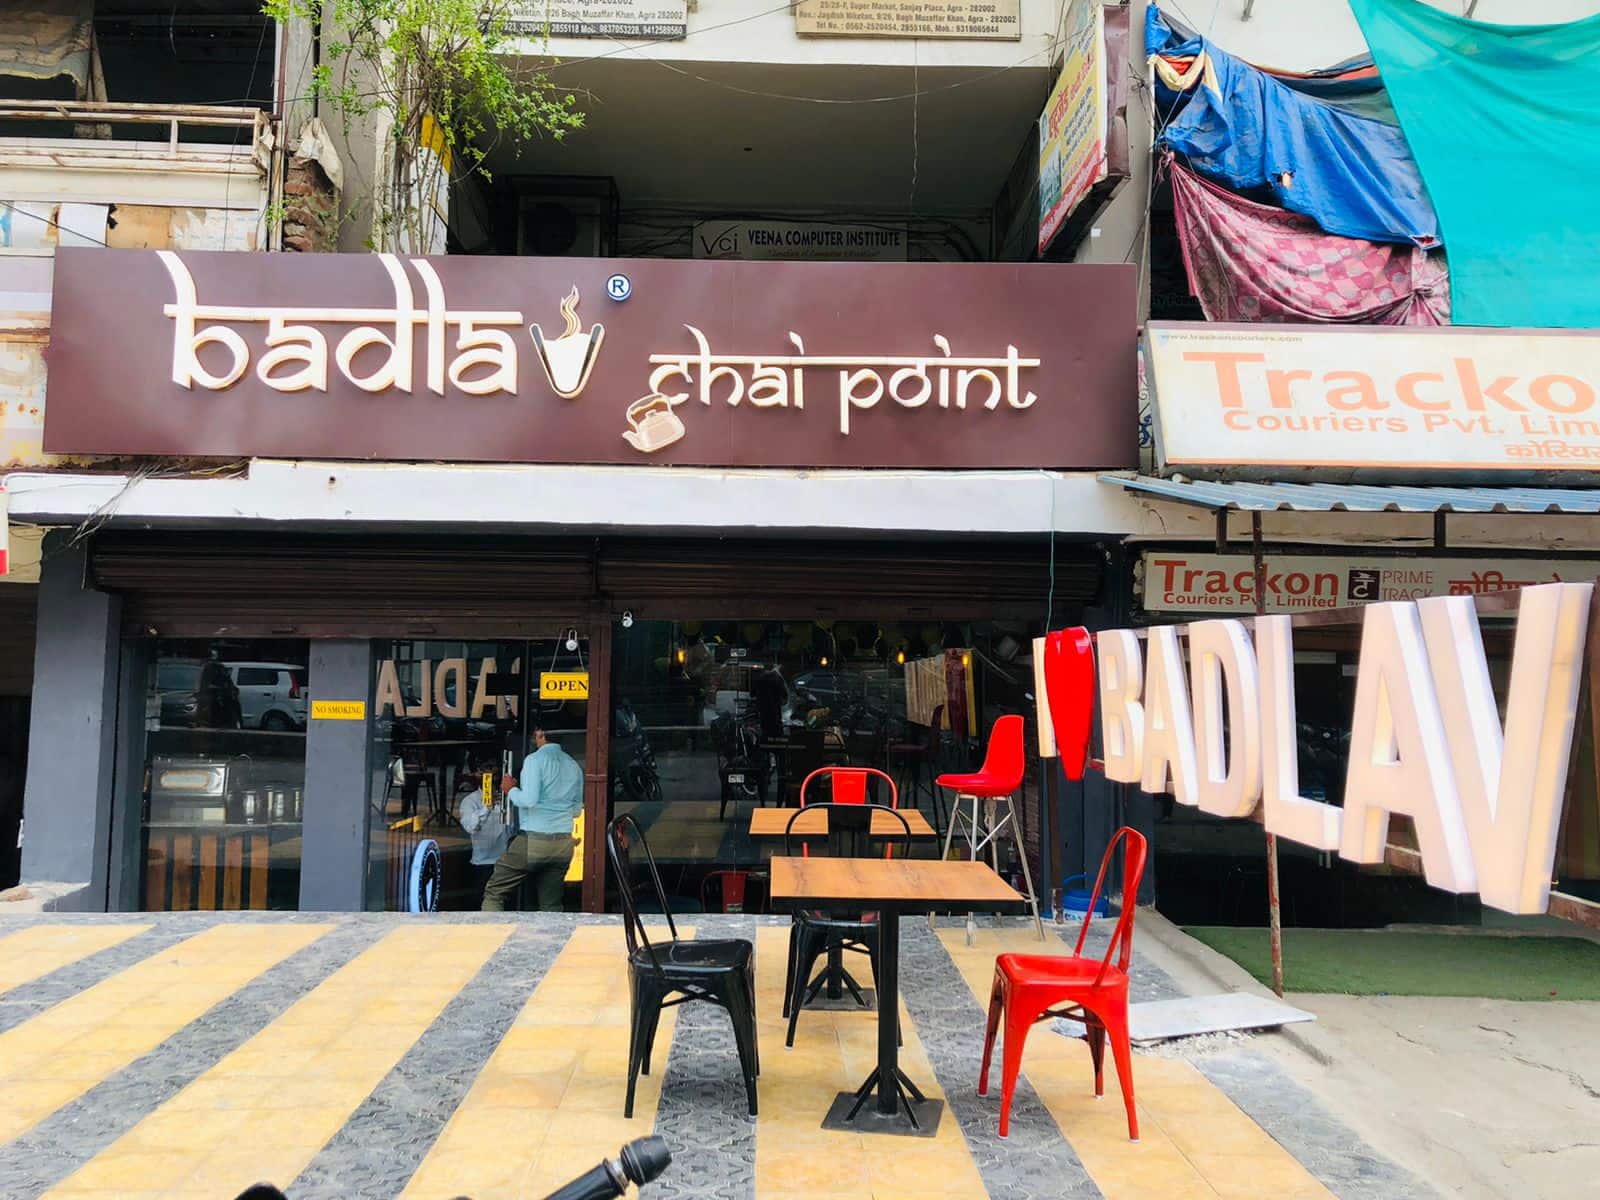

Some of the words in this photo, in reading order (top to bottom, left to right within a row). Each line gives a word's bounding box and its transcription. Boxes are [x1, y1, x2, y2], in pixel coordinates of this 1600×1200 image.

[748, 230, 783, 246] VEENA
[785, 230, 843, 247] COMPUTER
[846, 231, 901, 247] INSTITUTE
[648, 323, 806, 410] chai
[839, 333, 1042, 436] point
[1182, 351, 1597, 415] Tracko
[1223, 409, 1409, 433] Couriers
[1424, 413, 1505, 435] Pvt.
[1154, 560, 1339, 596] Trackon
[1383, 570, 1433, 584] PRIME
[1164, 592, 1234, 606] Couriers
[1276, 595, 1337, 608] Limited
[545, 679, 589, 692] OPEN
[314, 704, 327, 714] NO
[1097, 582, 1594, 915] BADLAV
